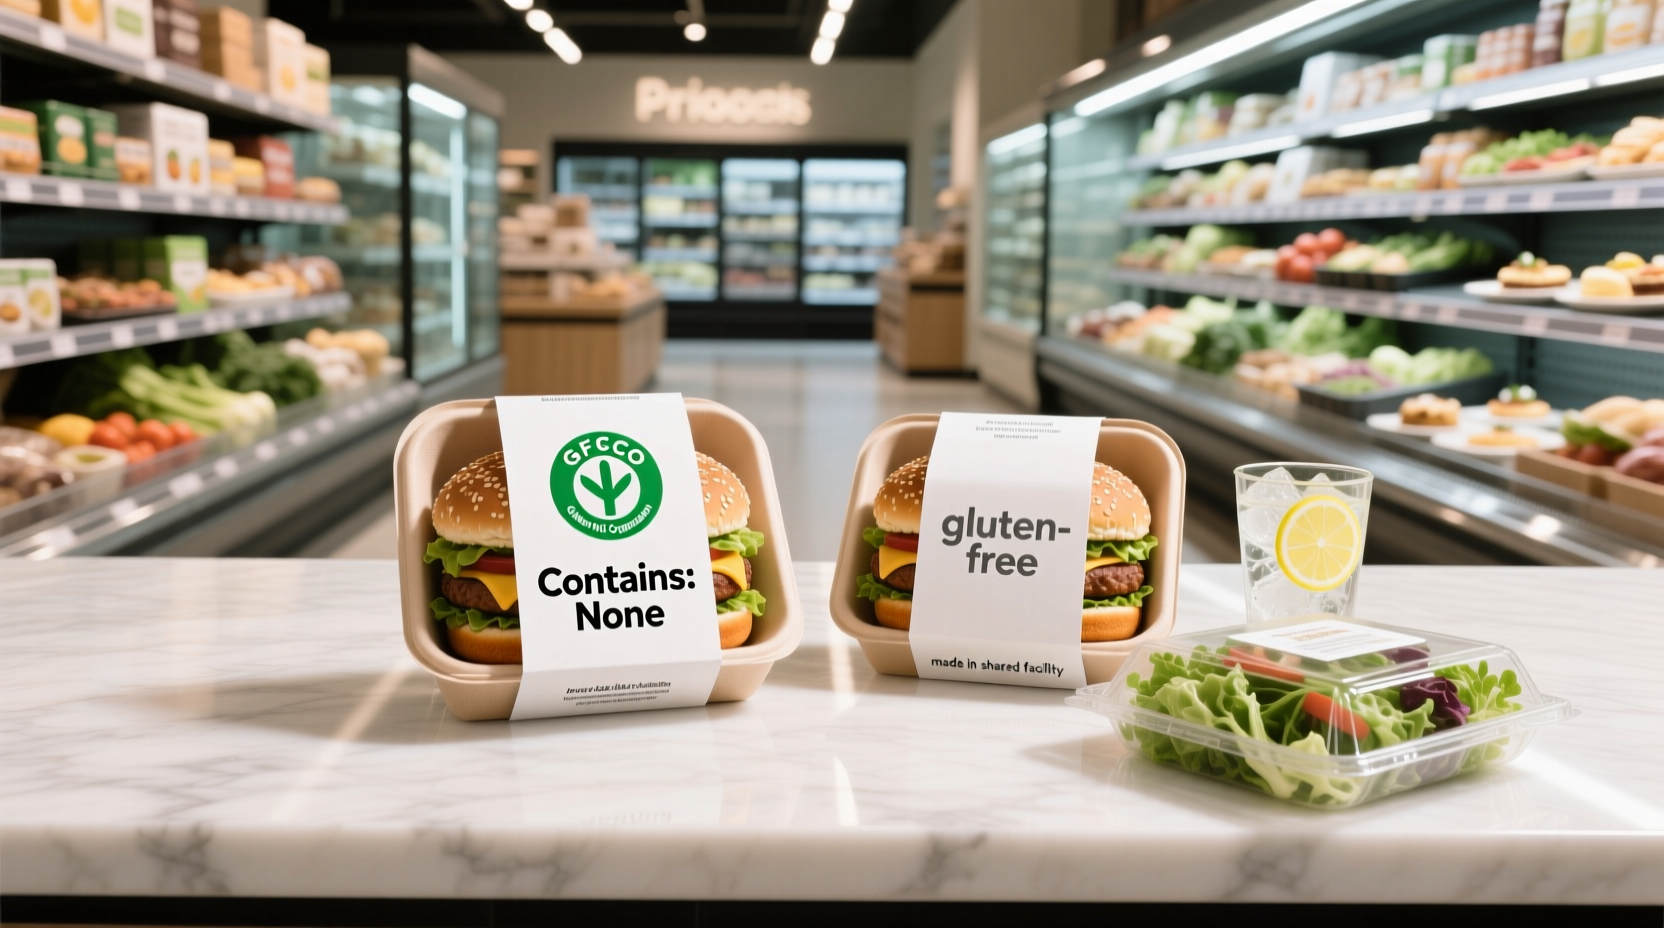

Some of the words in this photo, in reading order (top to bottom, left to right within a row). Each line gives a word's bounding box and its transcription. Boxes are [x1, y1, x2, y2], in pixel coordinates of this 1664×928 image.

[941, 506, 1071, 546] gluten-
[966, 542, 1038, 577] free
[538, 562, 696, 597] Contains:
[575, 601, 665, 631] None
[931, 657, 964, 669] made
[967, 658, 977, 670] in
[981, 660, 1020, 673] shared
